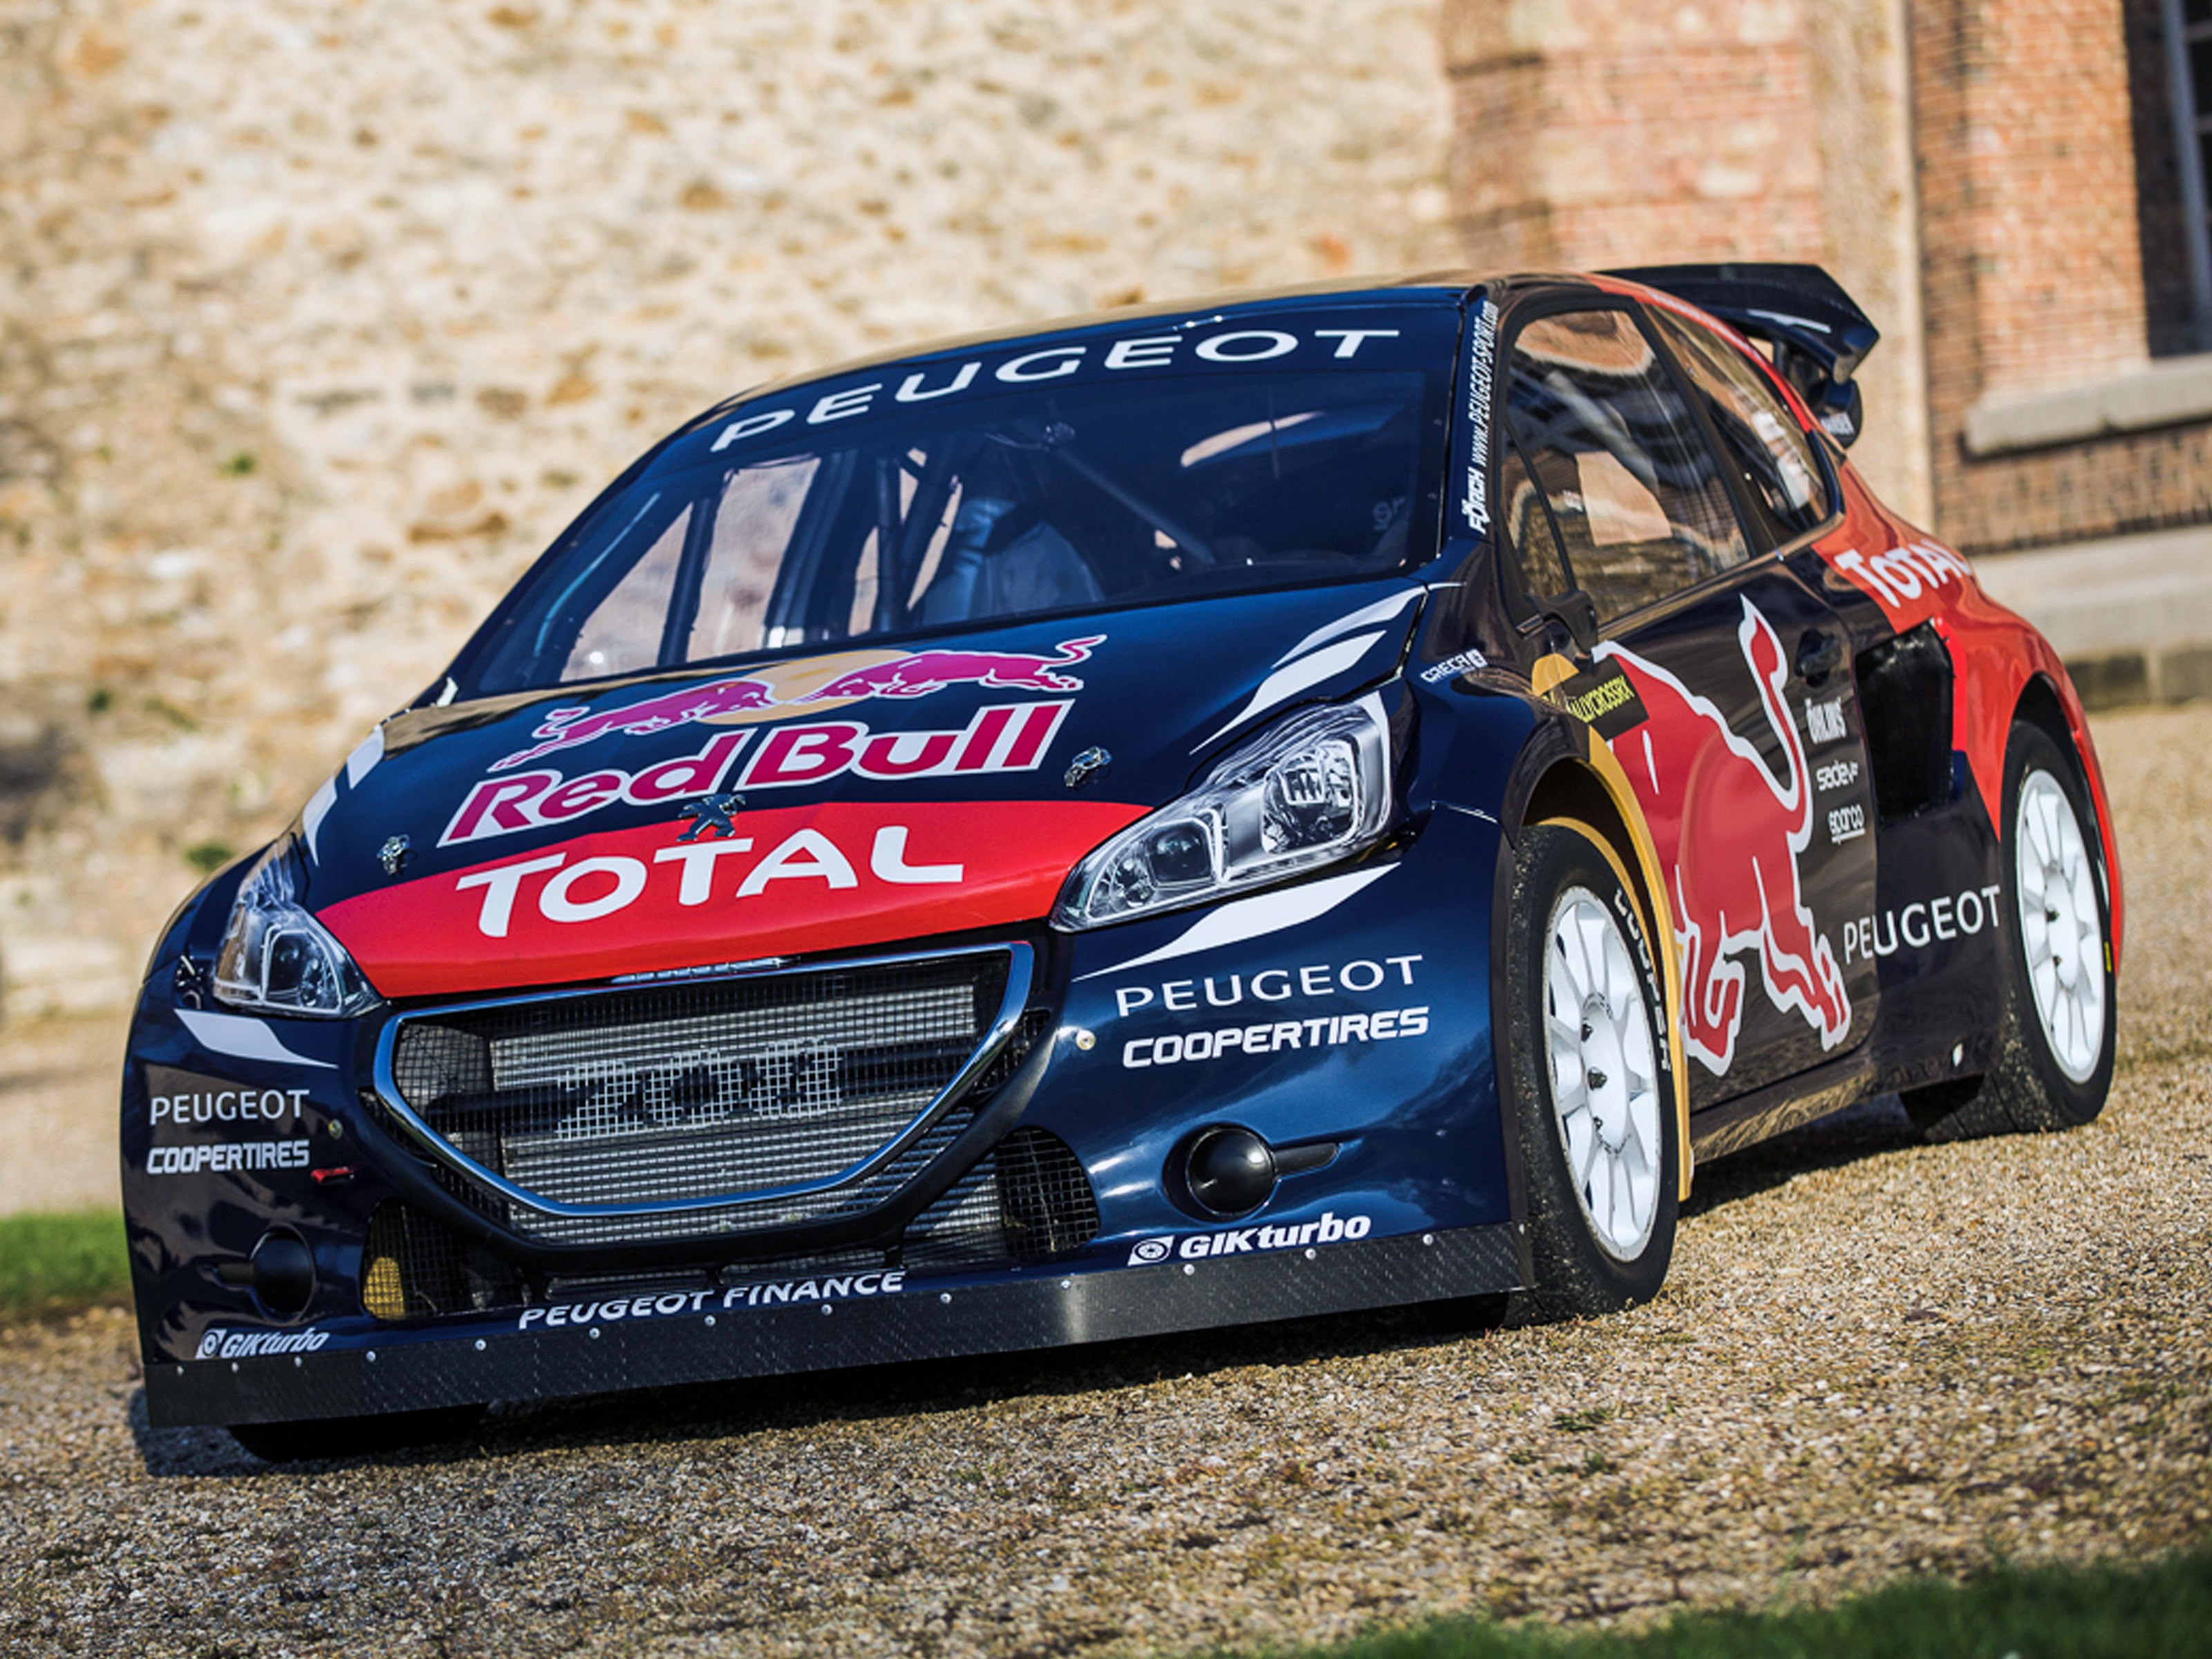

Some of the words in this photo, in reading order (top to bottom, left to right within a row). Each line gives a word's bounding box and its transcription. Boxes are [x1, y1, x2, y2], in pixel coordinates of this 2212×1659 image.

[711, 328, 1400, 453] PEUGEOT
[1834, 539, 1973, 608] TOTAL
[437, 727, 758, 847] Red
[733, 699, 1076, 792] Bull
[456, 825, 964, 938] TOTAL
[1844, 884, 2000, 964] PEUGEOT
[1116, 954, 1423, 1018] PEUGEOT
[1122, 1006, 1430, 1069] COOPERTIRES
[150, 1089, 310, 1125] PEUGEOT
[147, 1140, 309, 1174] COOPERTIRES
[1179, 1212, 1371, 1259] GIKturbo
[519, 1290, 715, 1330] PEUGEOT
[724, 1271, 906, 1308] FINANCE
[220, 1327, 330, 1360] GIKturbo
